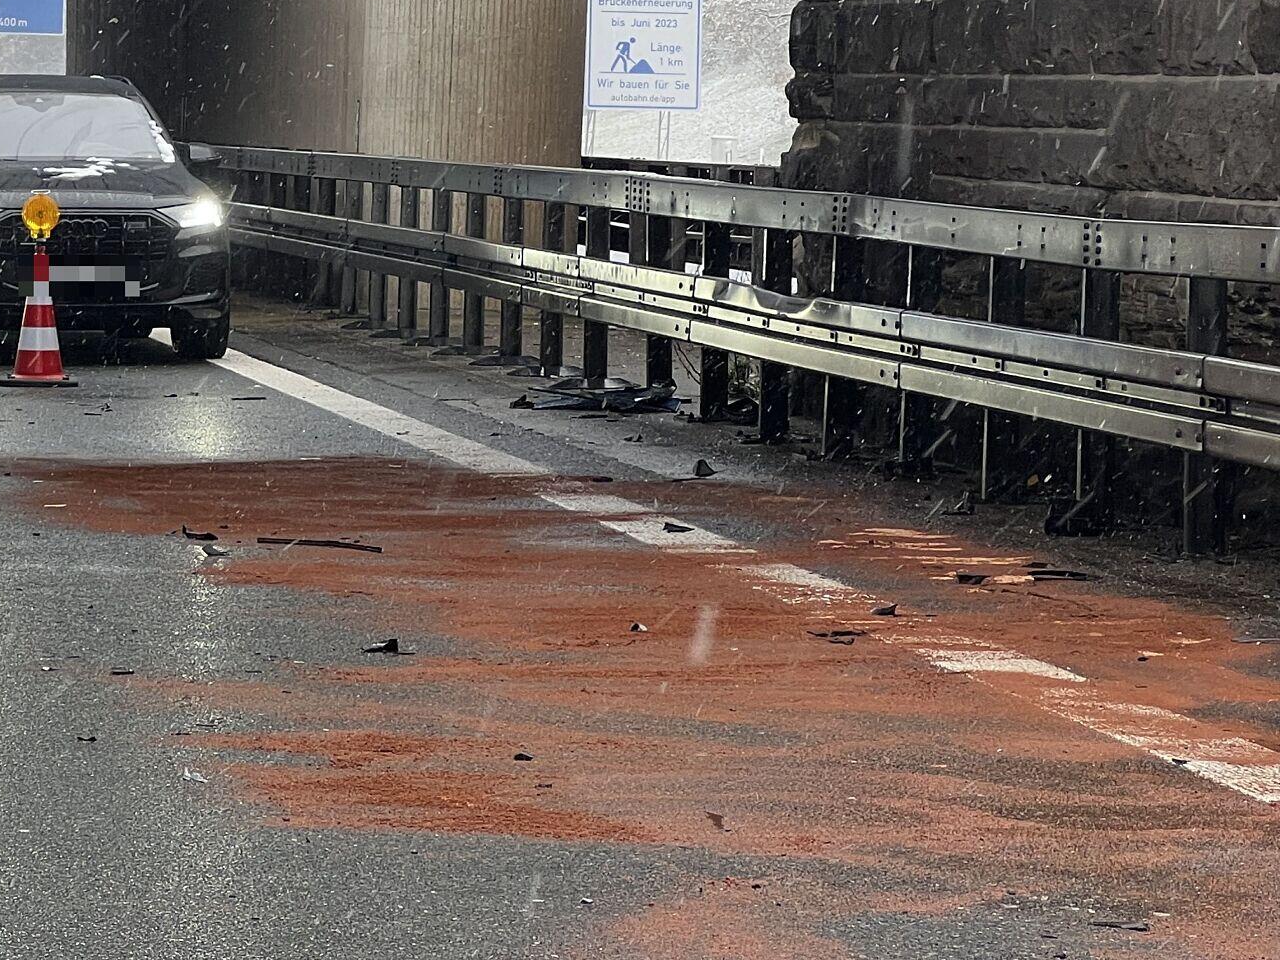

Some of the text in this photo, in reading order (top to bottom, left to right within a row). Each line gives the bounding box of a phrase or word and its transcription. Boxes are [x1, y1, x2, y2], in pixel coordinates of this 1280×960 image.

[611, 18, 678, 28] bis Juni 2023
[650, 42, 681, 54] Länge
[667, 57, 683, 66] km
[597, 78, 690, 90] Wir bauen für Sie
